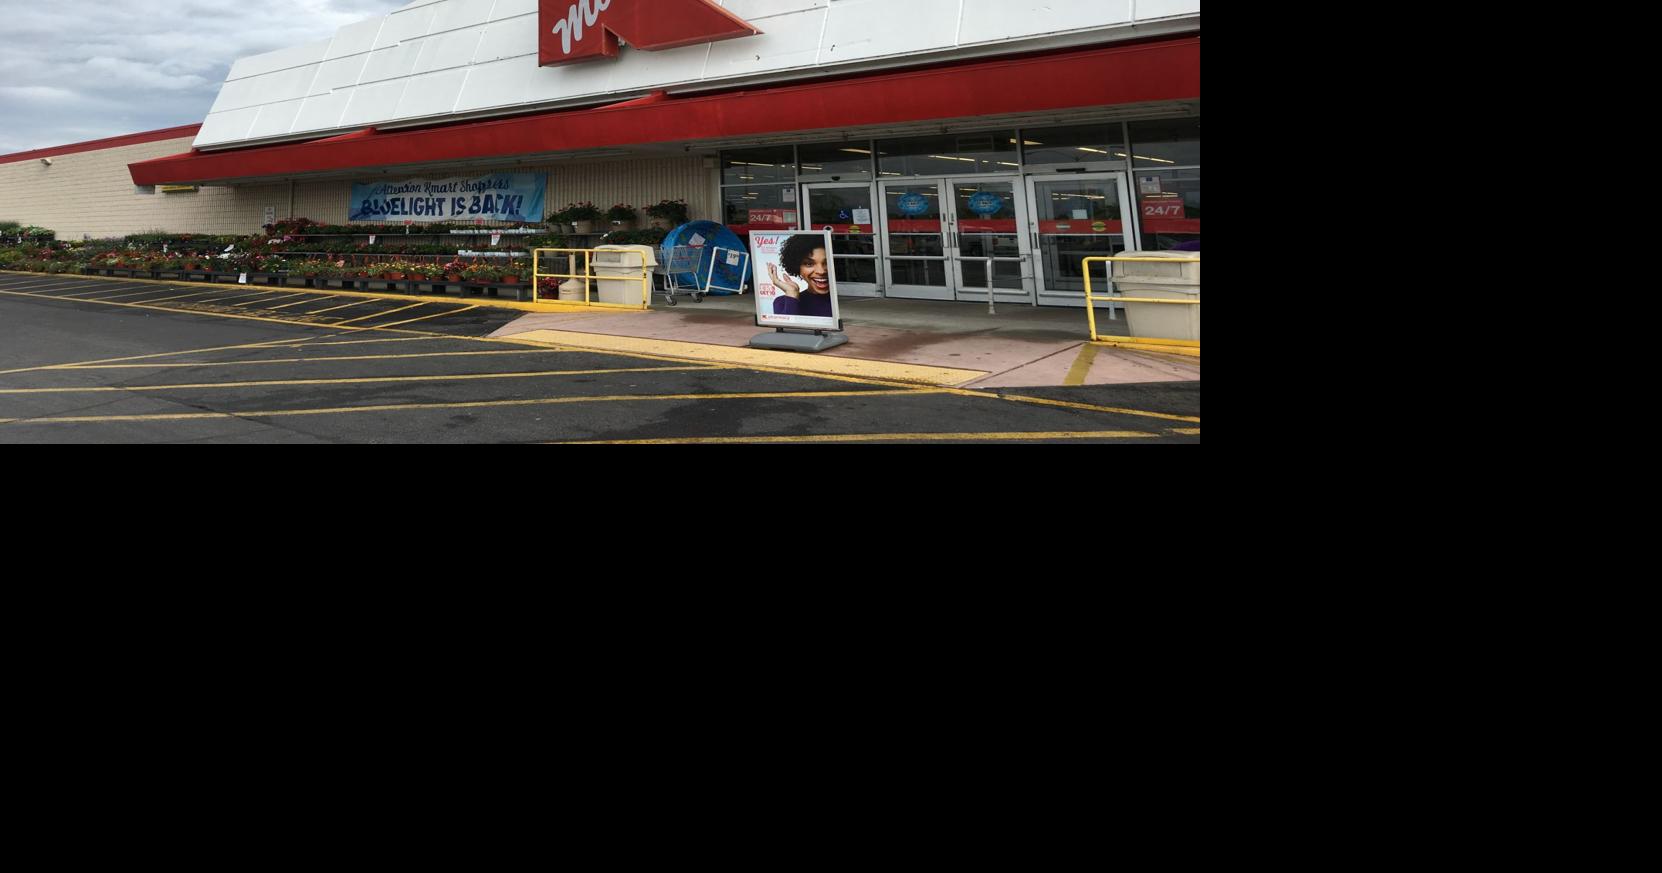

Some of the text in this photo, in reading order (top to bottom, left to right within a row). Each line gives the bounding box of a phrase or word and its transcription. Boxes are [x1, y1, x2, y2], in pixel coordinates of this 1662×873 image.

[424, 180, 458, 196] Kmart
[361, 194, 523, 217] BLUELIGHT IS BACK!
[1145, 205, 1180, 216] 24/7
[755, 235, 780, 248] Yes!
